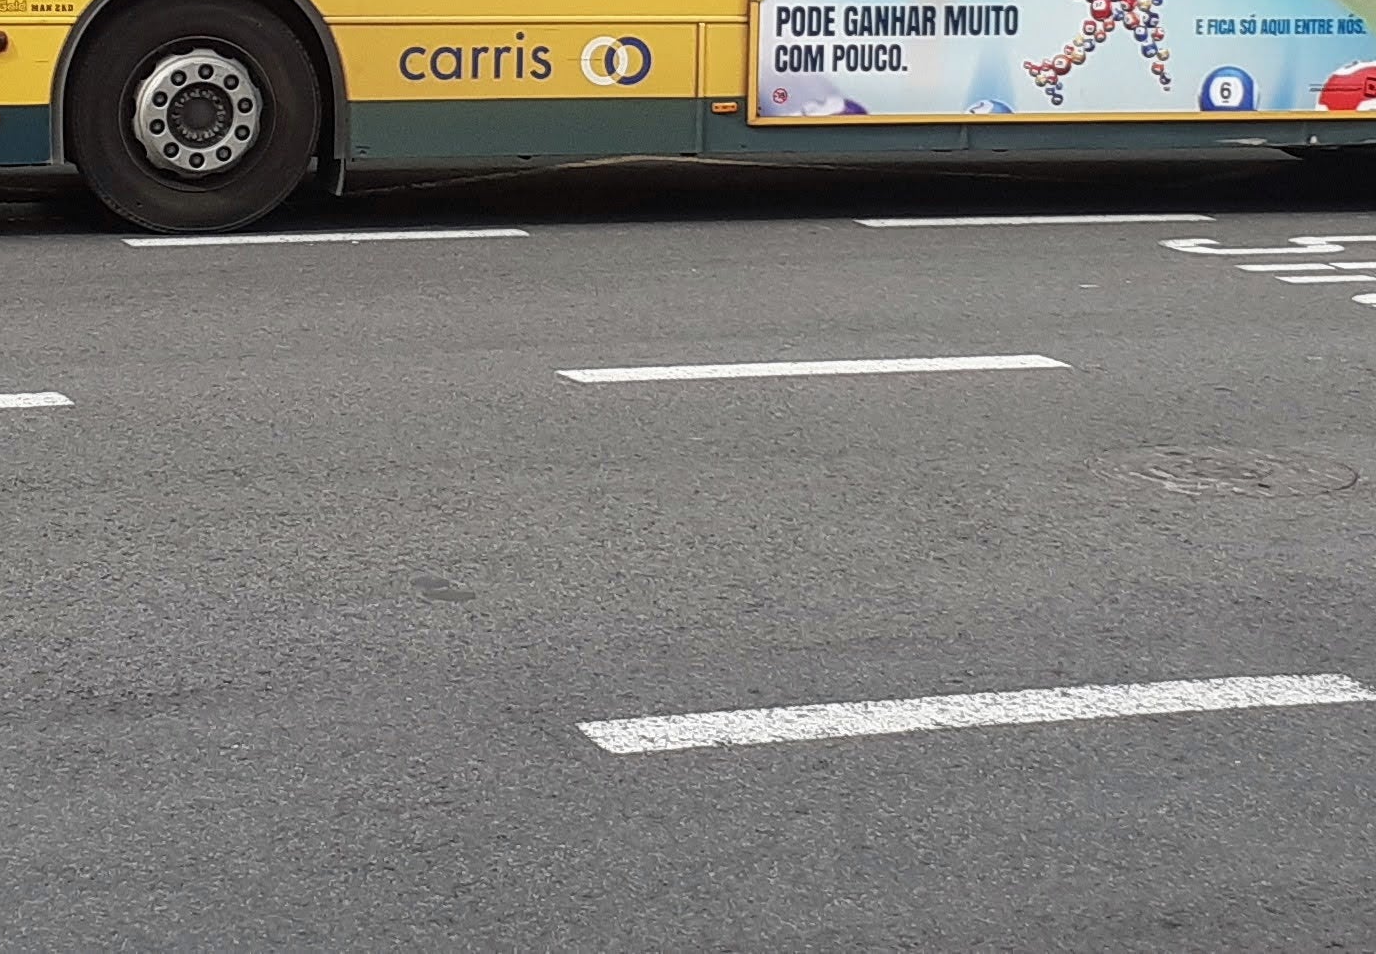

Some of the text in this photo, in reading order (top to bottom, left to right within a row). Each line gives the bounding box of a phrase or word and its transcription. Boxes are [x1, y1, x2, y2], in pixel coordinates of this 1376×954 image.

[775, 4, 1019, 37] PODE GANHAR MUITO
[1195, 14, 1367, 35] E FICA SÓ AQUI ENTRE NÓS.
[399, 31, 552, 80] carris
[774, 43, 909, 73] COM POUCO.
